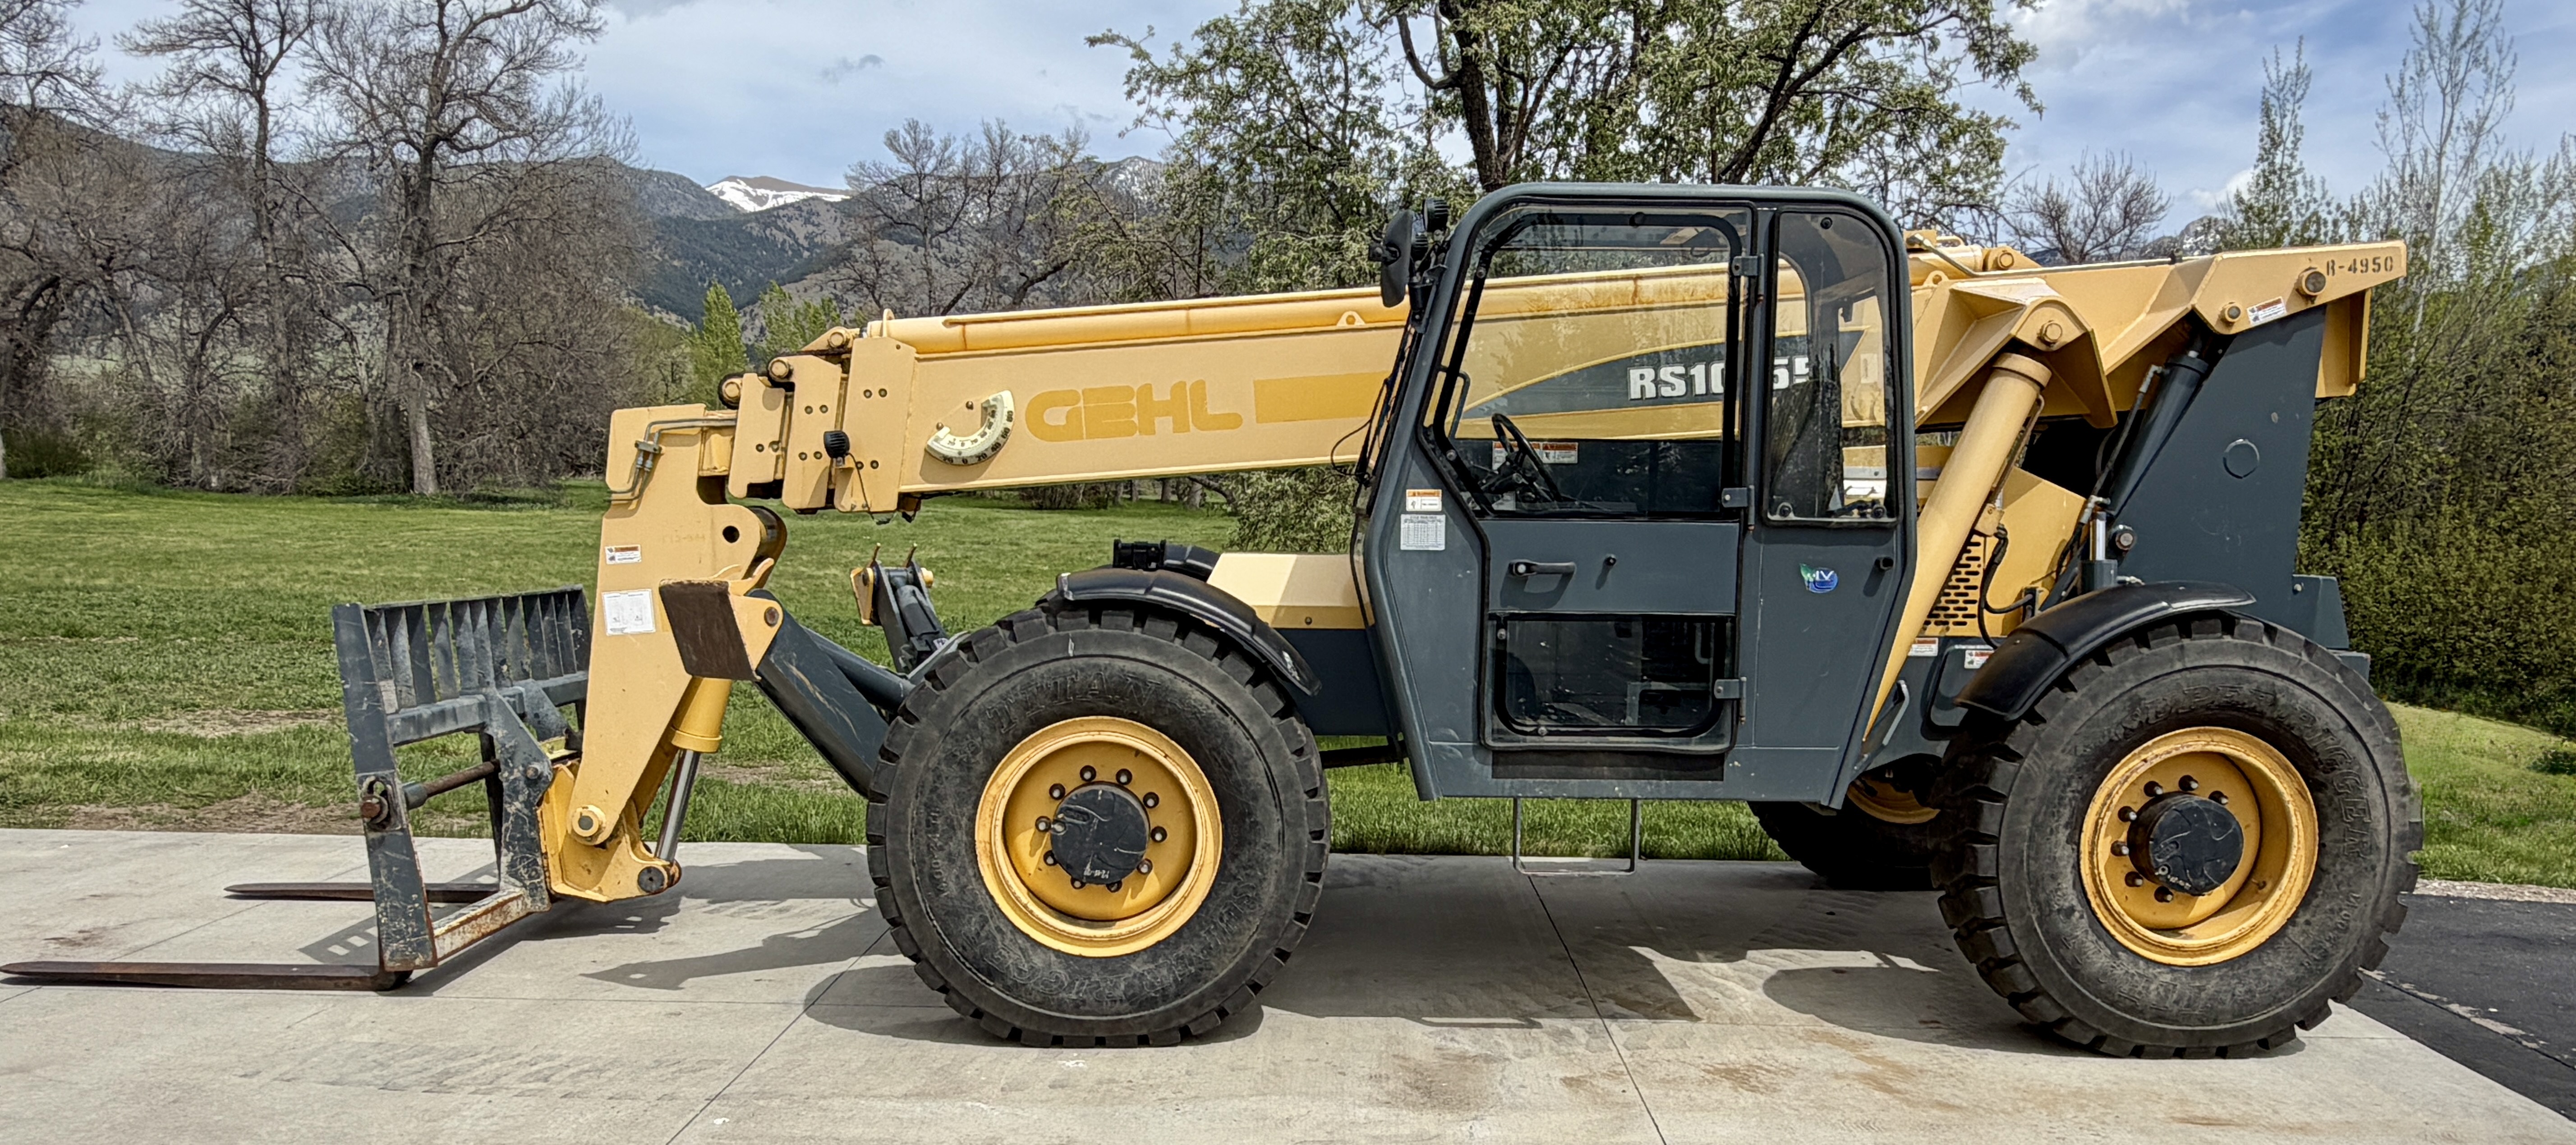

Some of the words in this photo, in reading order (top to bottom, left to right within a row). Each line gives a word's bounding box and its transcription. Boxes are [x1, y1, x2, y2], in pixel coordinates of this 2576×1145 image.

[2326, 256, 2394, 276] R-4950
[1025, 379, 1243, 442] GEHL
[1000, 427, 1011, 439] 60
[986, 668, 1162, 735] TITAN
